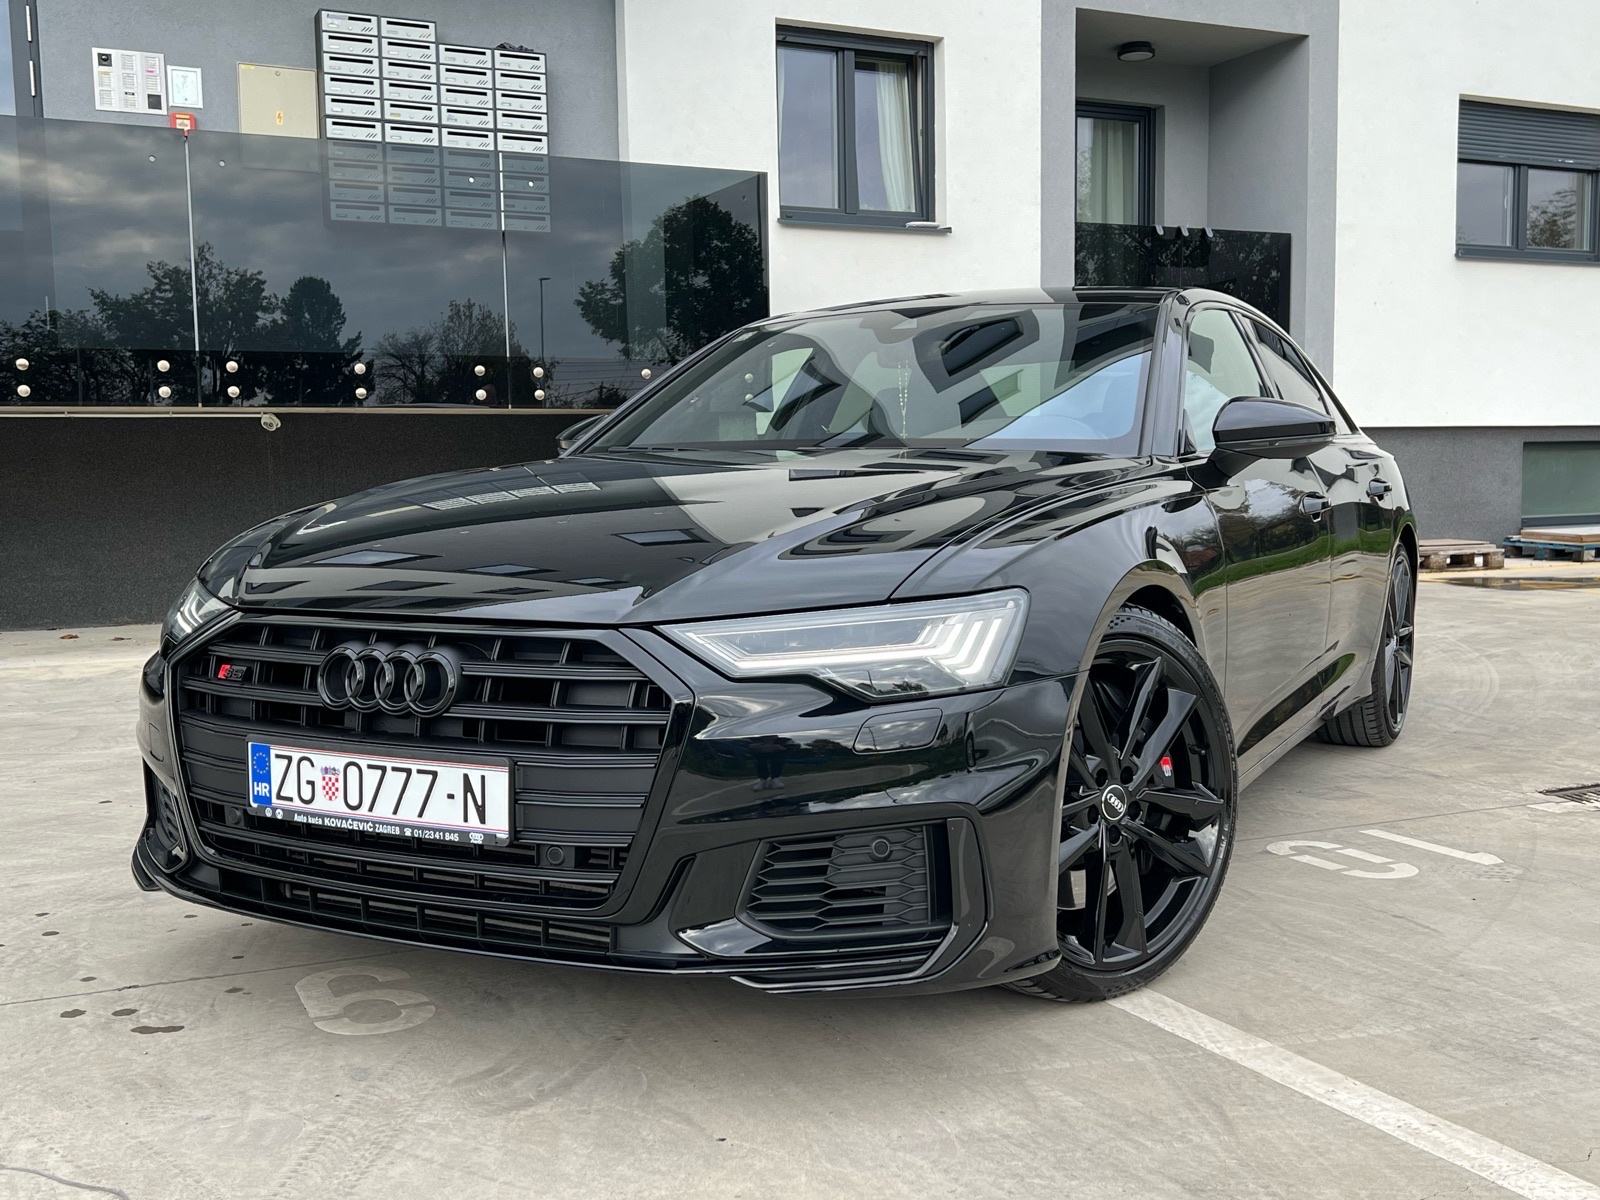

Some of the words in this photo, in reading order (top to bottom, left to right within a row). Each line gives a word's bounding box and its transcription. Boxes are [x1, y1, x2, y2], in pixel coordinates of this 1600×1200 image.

[253, 781, 270, 797] HR
[274, 753, 316, 805] ZG
[343, 761, 486, 824] 0777-N
[293, 813, 307, 823] Auto
[324, 817, 374, 831] KOVAČEVIĆ
[375, 824, 400, 835] ZAGREB
